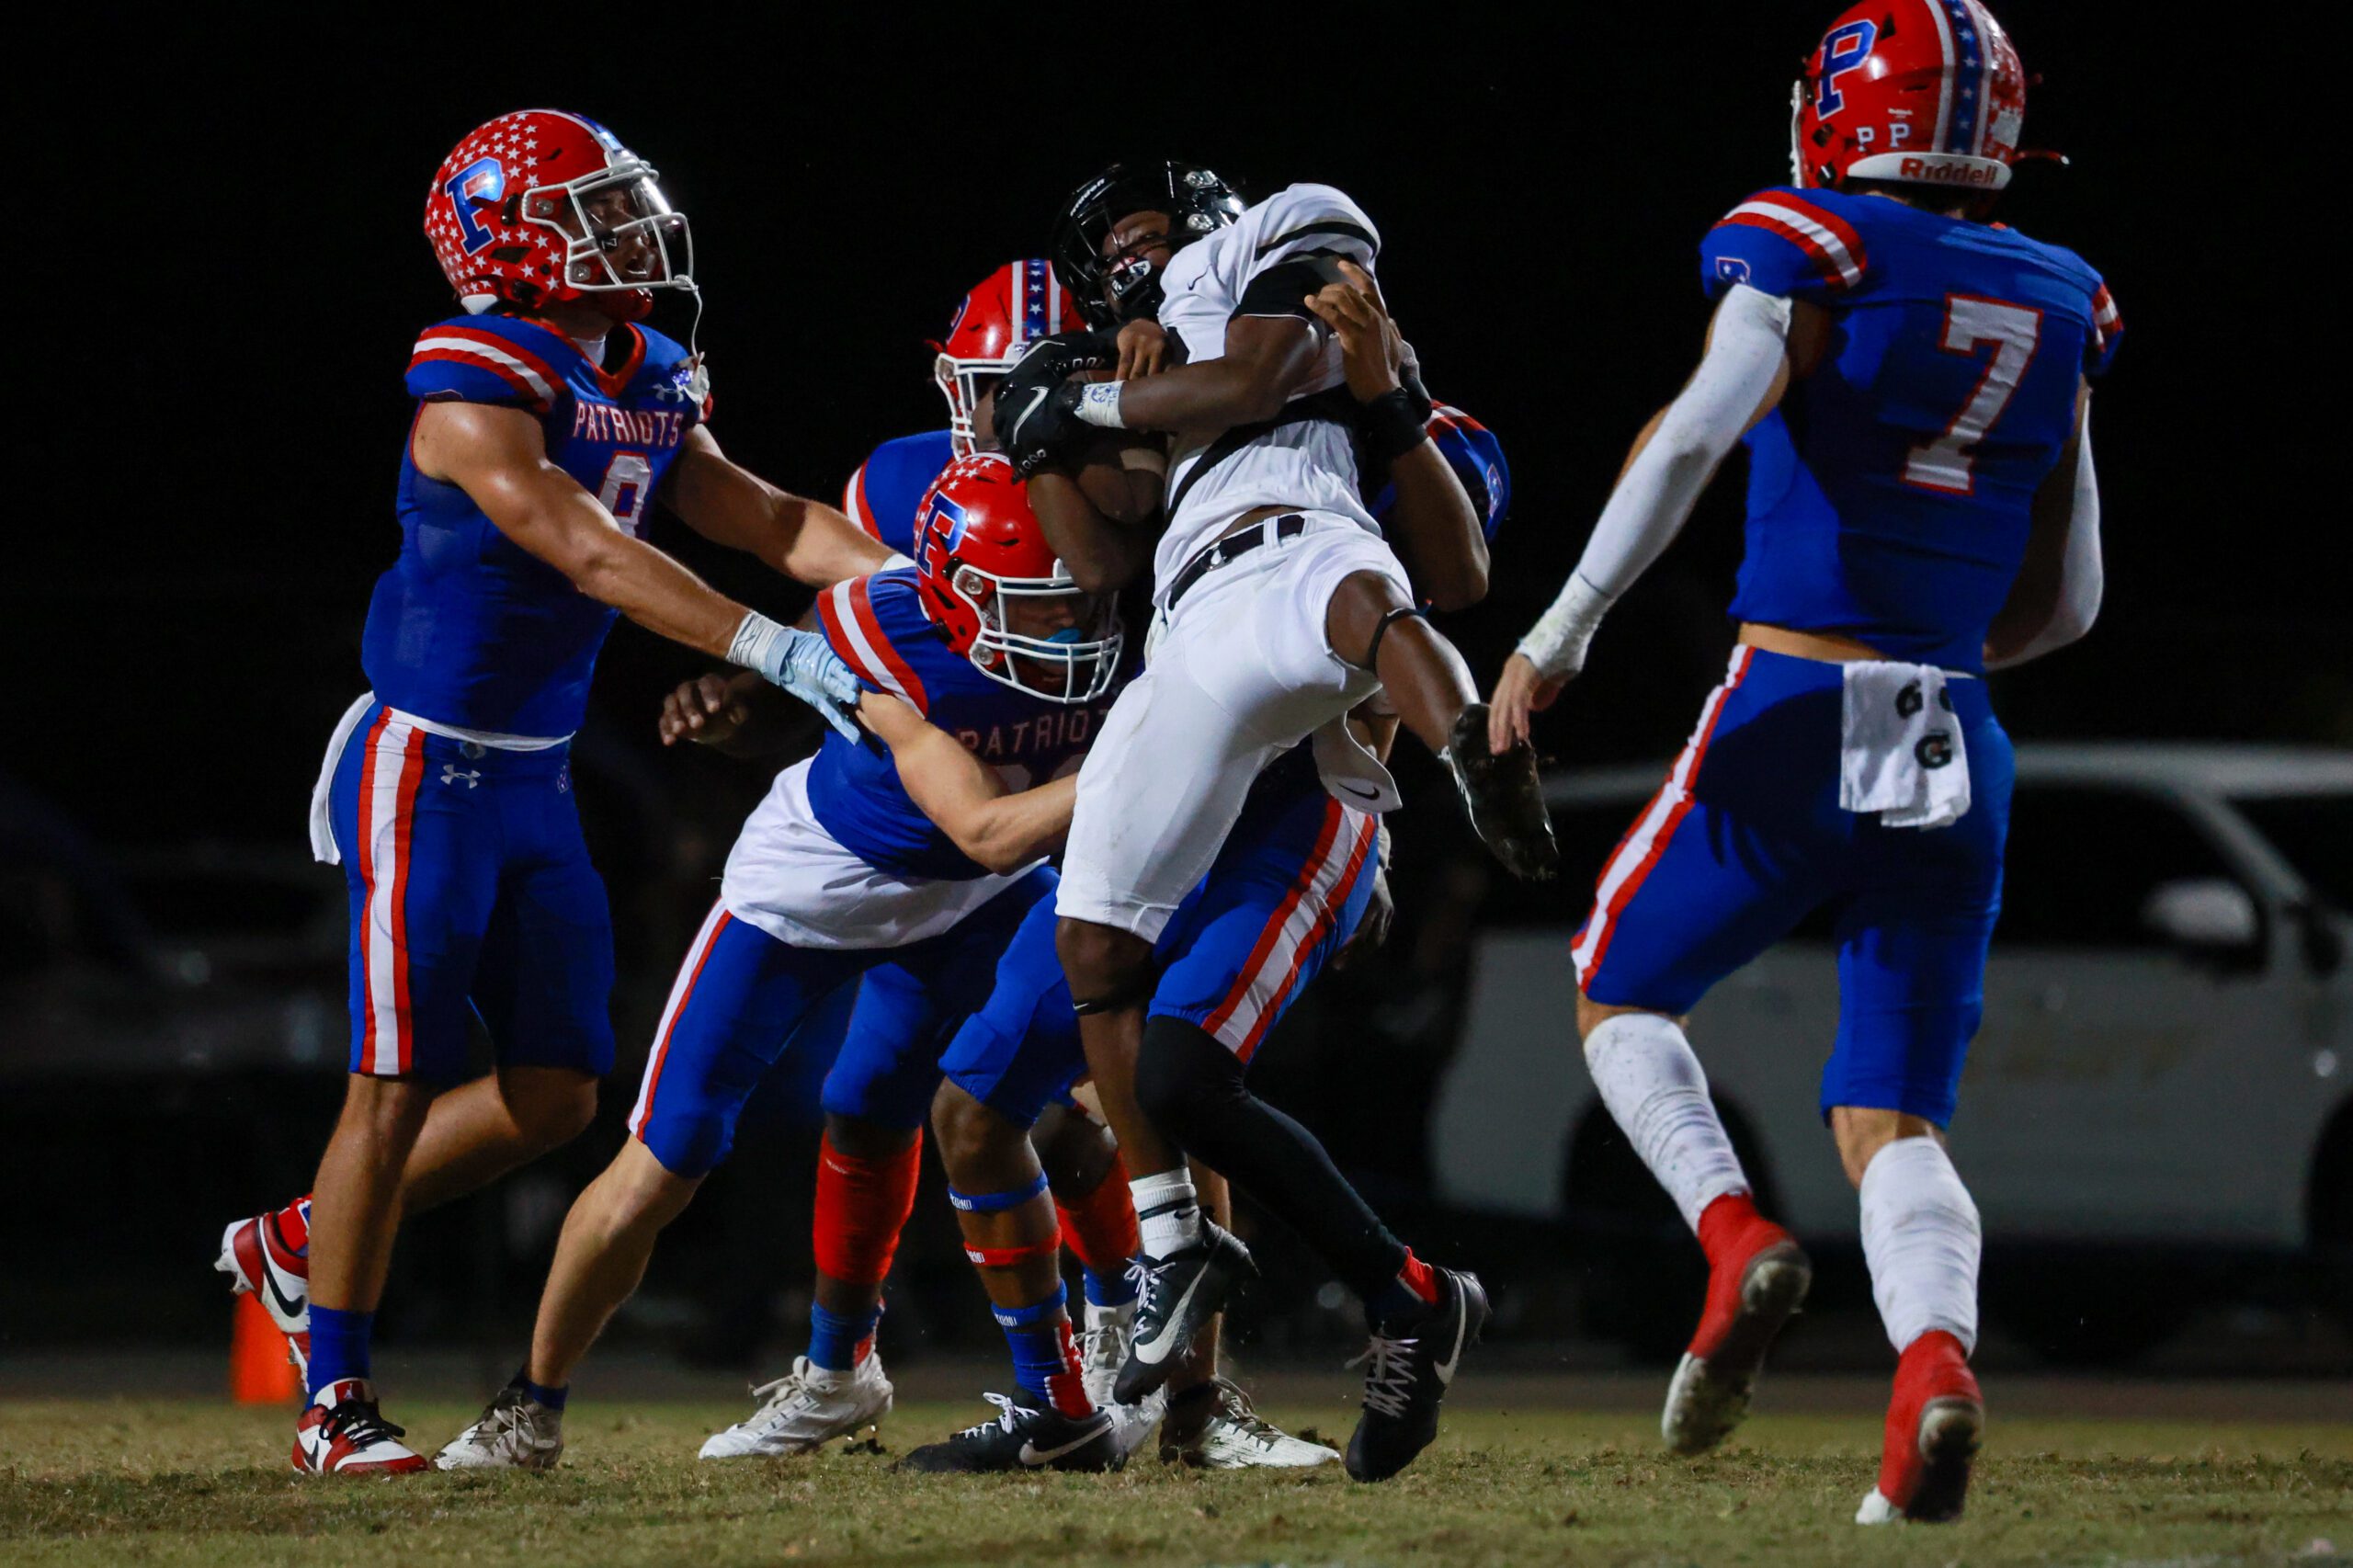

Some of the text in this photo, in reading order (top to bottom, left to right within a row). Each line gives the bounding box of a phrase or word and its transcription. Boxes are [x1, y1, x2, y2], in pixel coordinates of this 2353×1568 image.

[1815, 18, 1878, 120] P
[1900, 157, 1998, 185] Riddell
[573, 400, 685, 448] PATRIOTS
[1899, 292, 2044, 495] 7
